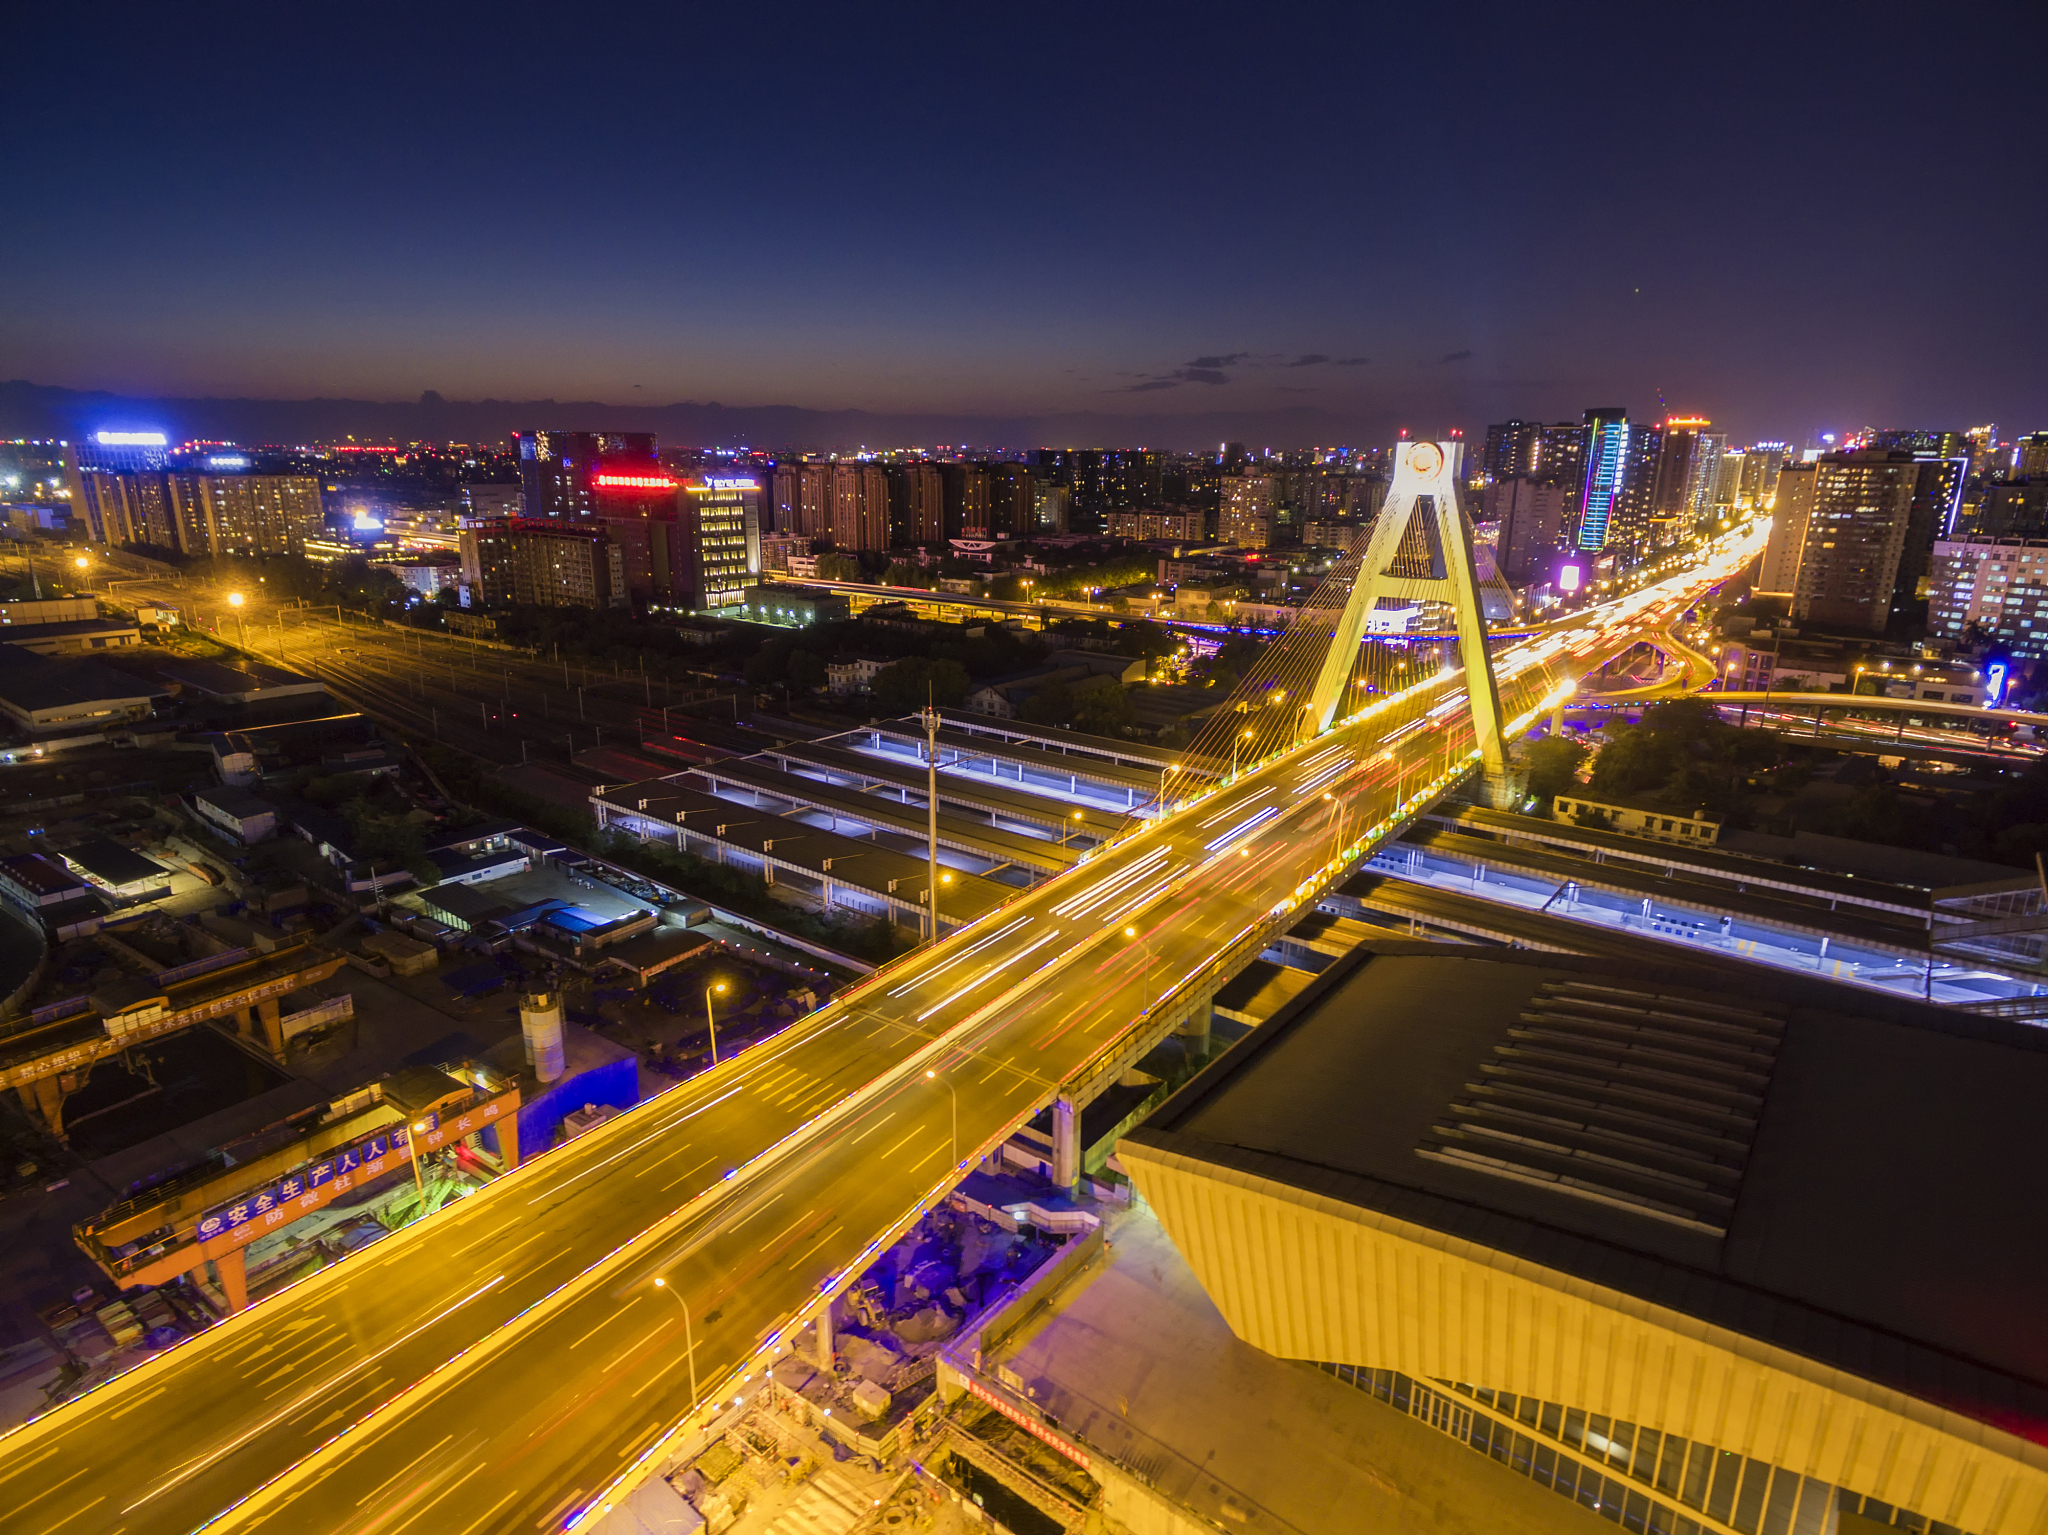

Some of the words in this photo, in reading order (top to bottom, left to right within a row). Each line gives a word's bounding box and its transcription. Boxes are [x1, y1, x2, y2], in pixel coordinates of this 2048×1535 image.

[150, 1008, 203, 1034] 技术先行
[209, 978, 295, 1014] 创安全优质工程
[228, 1115, 436, 1227] 安全生产人人有责
